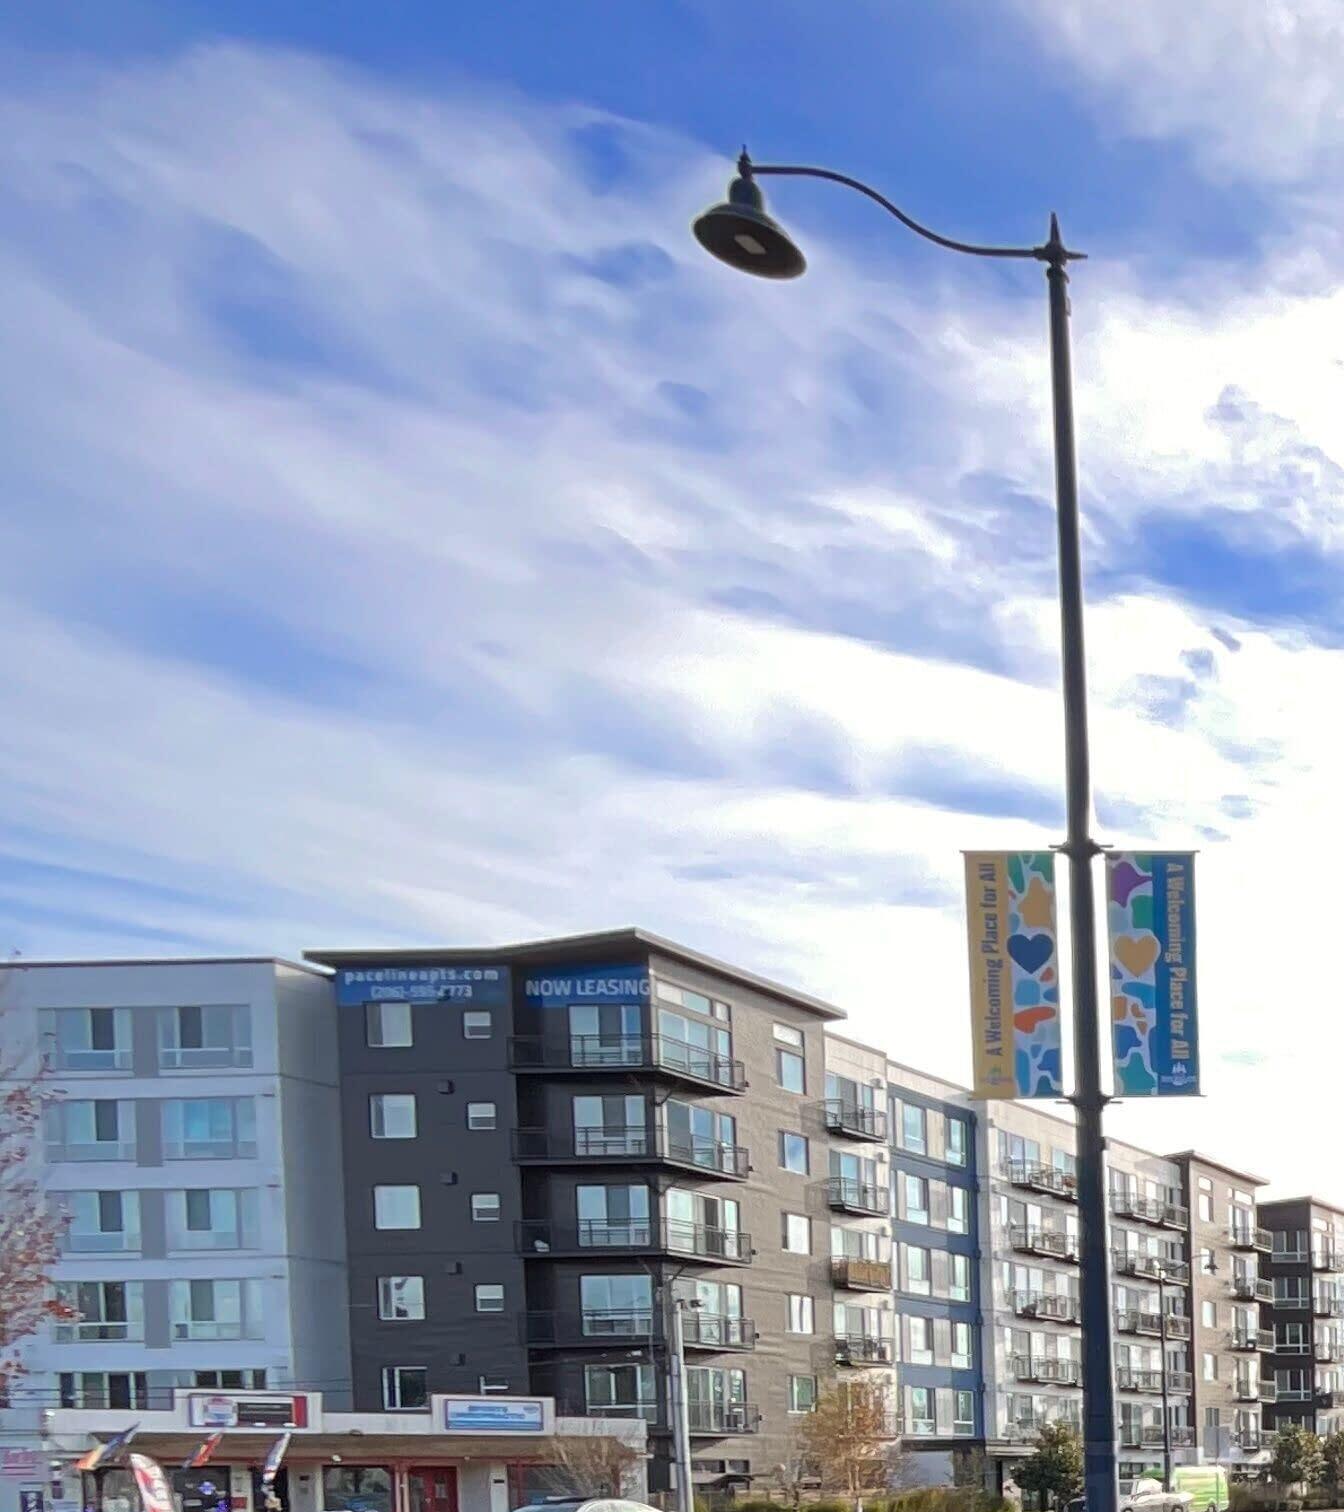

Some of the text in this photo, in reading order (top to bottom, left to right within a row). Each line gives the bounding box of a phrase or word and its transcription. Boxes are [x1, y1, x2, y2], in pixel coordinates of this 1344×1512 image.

[978, 863, 996, 881] All
[1166, 863, 1184, 873] A
[979, 886, 997, 908] for
[1164, 876, 1186, 963] Welcoming
[981, 913, 999, 954] Place
[526, 979, 650, 996] NOW LEASING
[1169, 967, 1188, 1010] Place
[983, 959, 1004, 1043] Welcoming
[1170, 1013, 1189, 1035] for
[985, 1047, 1003, 1056] A
[1171, 1039, 1190, 1059] All
